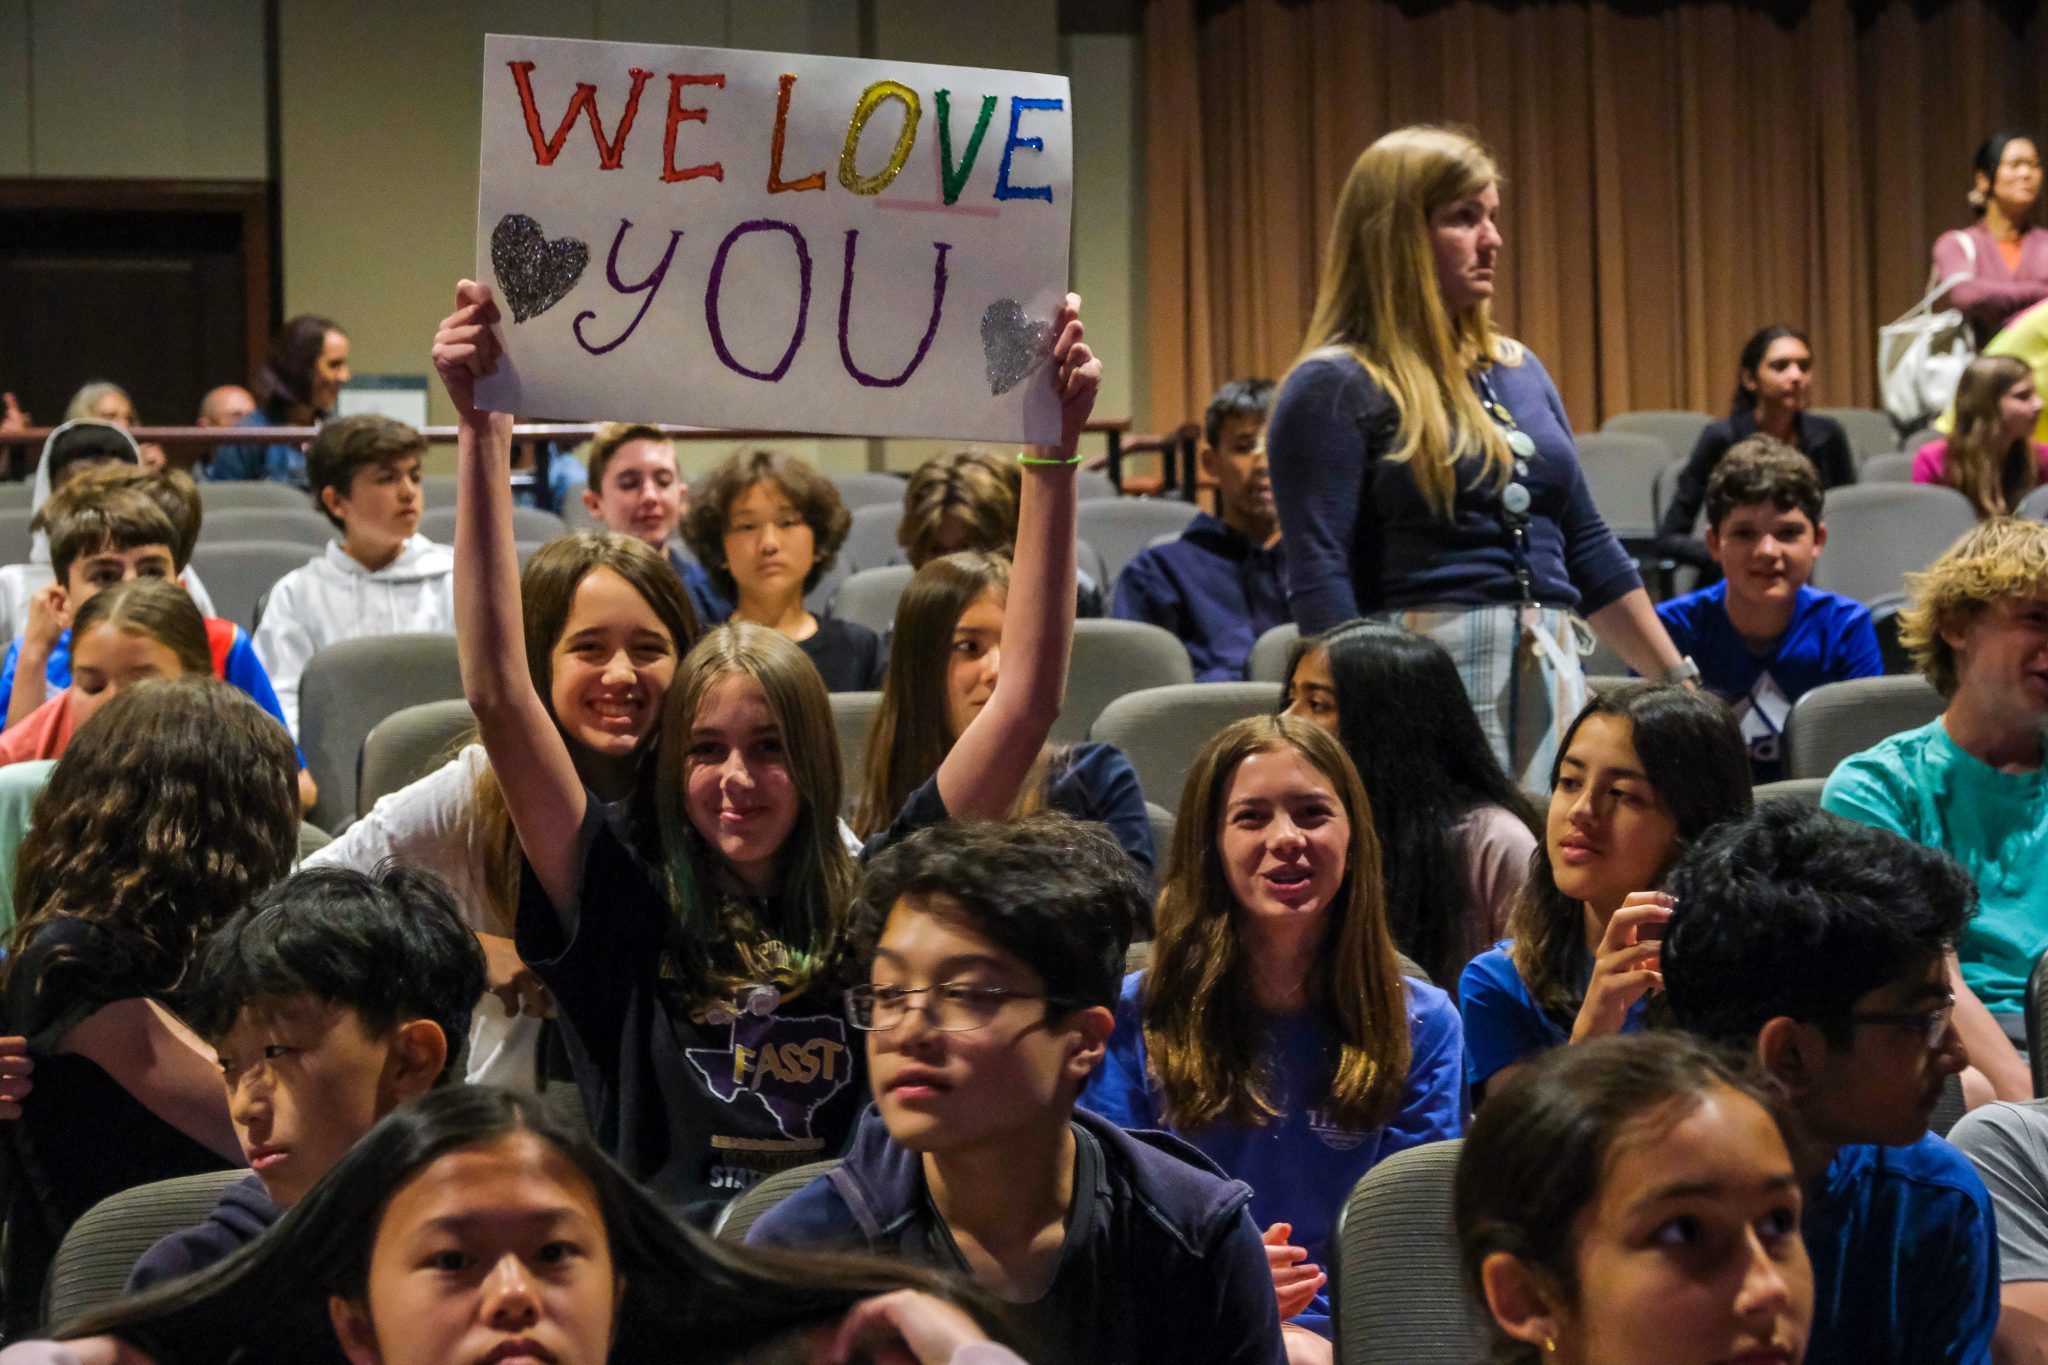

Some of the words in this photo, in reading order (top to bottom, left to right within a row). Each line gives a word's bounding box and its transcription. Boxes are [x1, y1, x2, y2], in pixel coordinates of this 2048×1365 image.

[506, 61, 726, 184] WE
[766, 73, 1064, 206] LOVE
[732, 1037, 844, 1092] FASST
